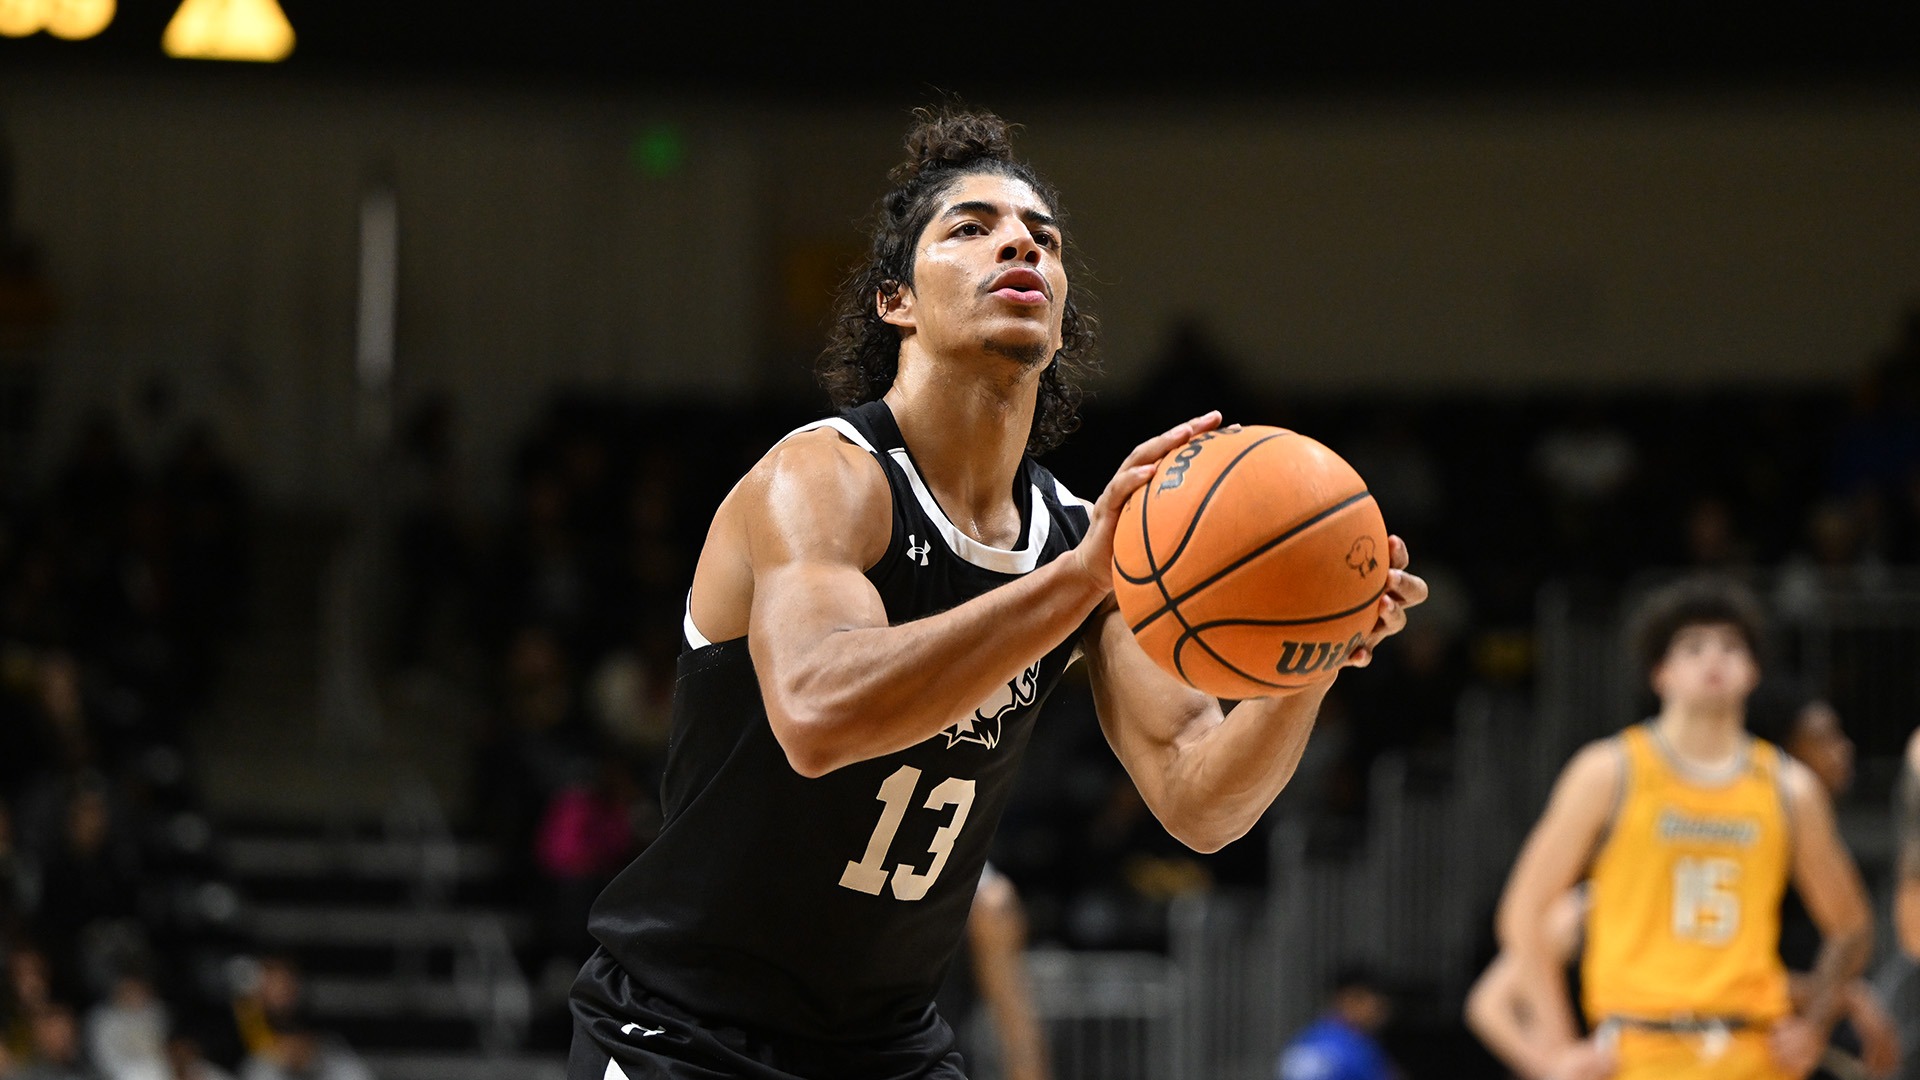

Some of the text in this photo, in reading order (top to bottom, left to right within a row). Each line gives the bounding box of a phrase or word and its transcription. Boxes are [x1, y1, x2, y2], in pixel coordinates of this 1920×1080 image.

[1276, 631, 1362, 675] Wil
[838, 765, 976, 901] 13
[1671, 857, 1741, 946] 15
